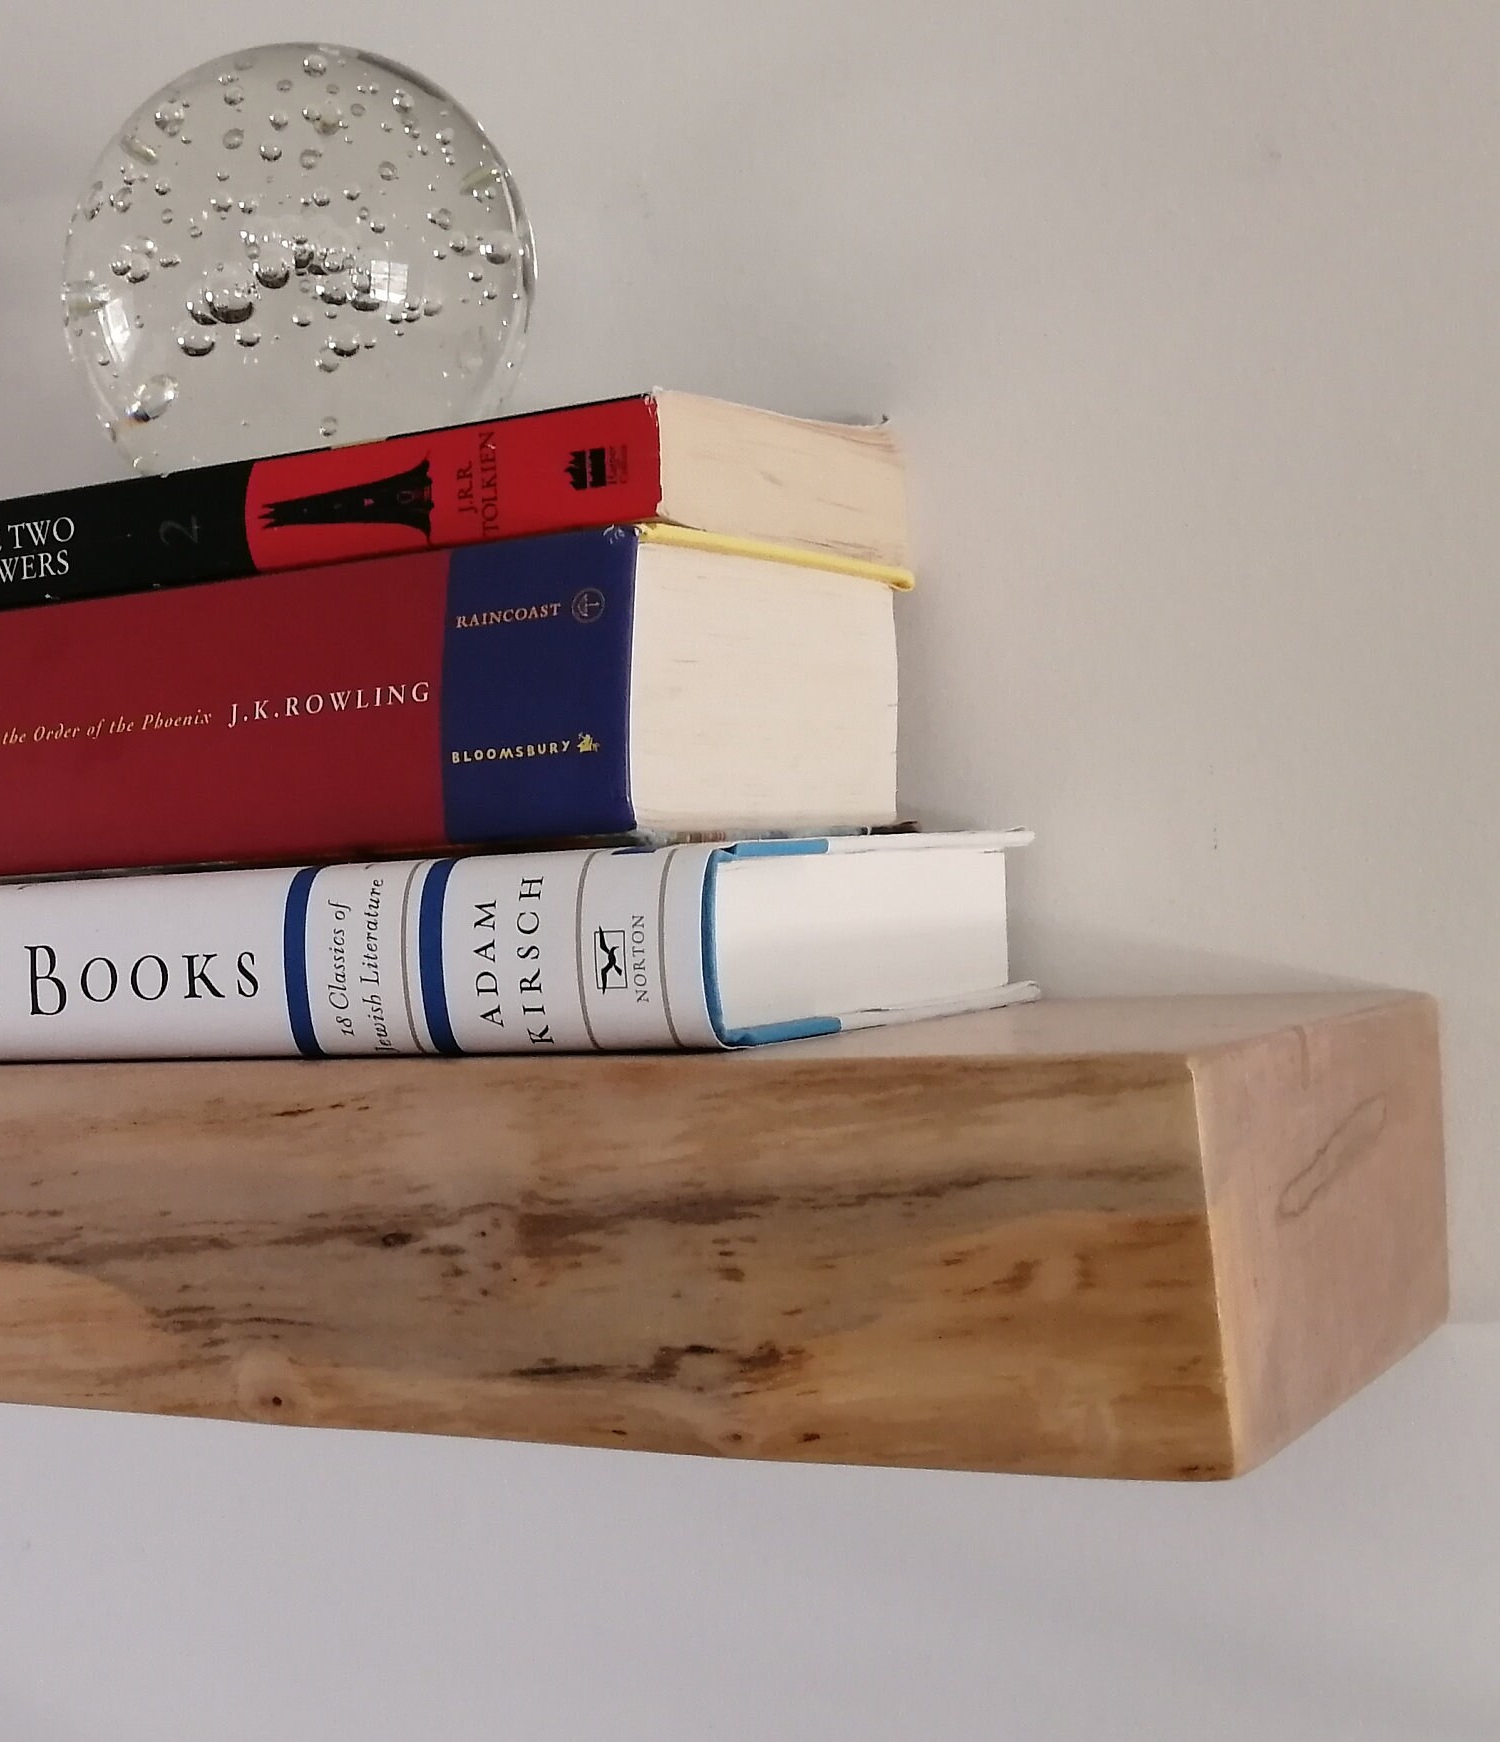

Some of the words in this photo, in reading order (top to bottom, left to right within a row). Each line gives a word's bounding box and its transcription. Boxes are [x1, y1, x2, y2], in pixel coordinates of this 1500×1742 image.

[479, 431, 500, 537] TOLKIEN
[7, 516, 75, 550] TWO
[455, 602, 562, 629] RAINCOAST
[2, 727, 27, 746] the
[33, 723, 81, 742] Order
[86, 718, 105, 740] of
[109, 715, 135, 734] the
[141, 709, 213, 731] Phoenix
[451, 740, 571, 765] BLOOMSBURY
[328, 899, 352, 920] of
[360, 878, 385, 986] Literature
[24, 943, 260, 1017] BOOKS
[328, 928, 350, 1010] Classics
[473, 899, 504, 1027] ADAM
[516, 876, 555, 1045] KIRSCH
[631, 914, 650, 1003] NORTON
[335, 1015, 355, 1037] 18
[362, 994, 398, 1055] Jewish
